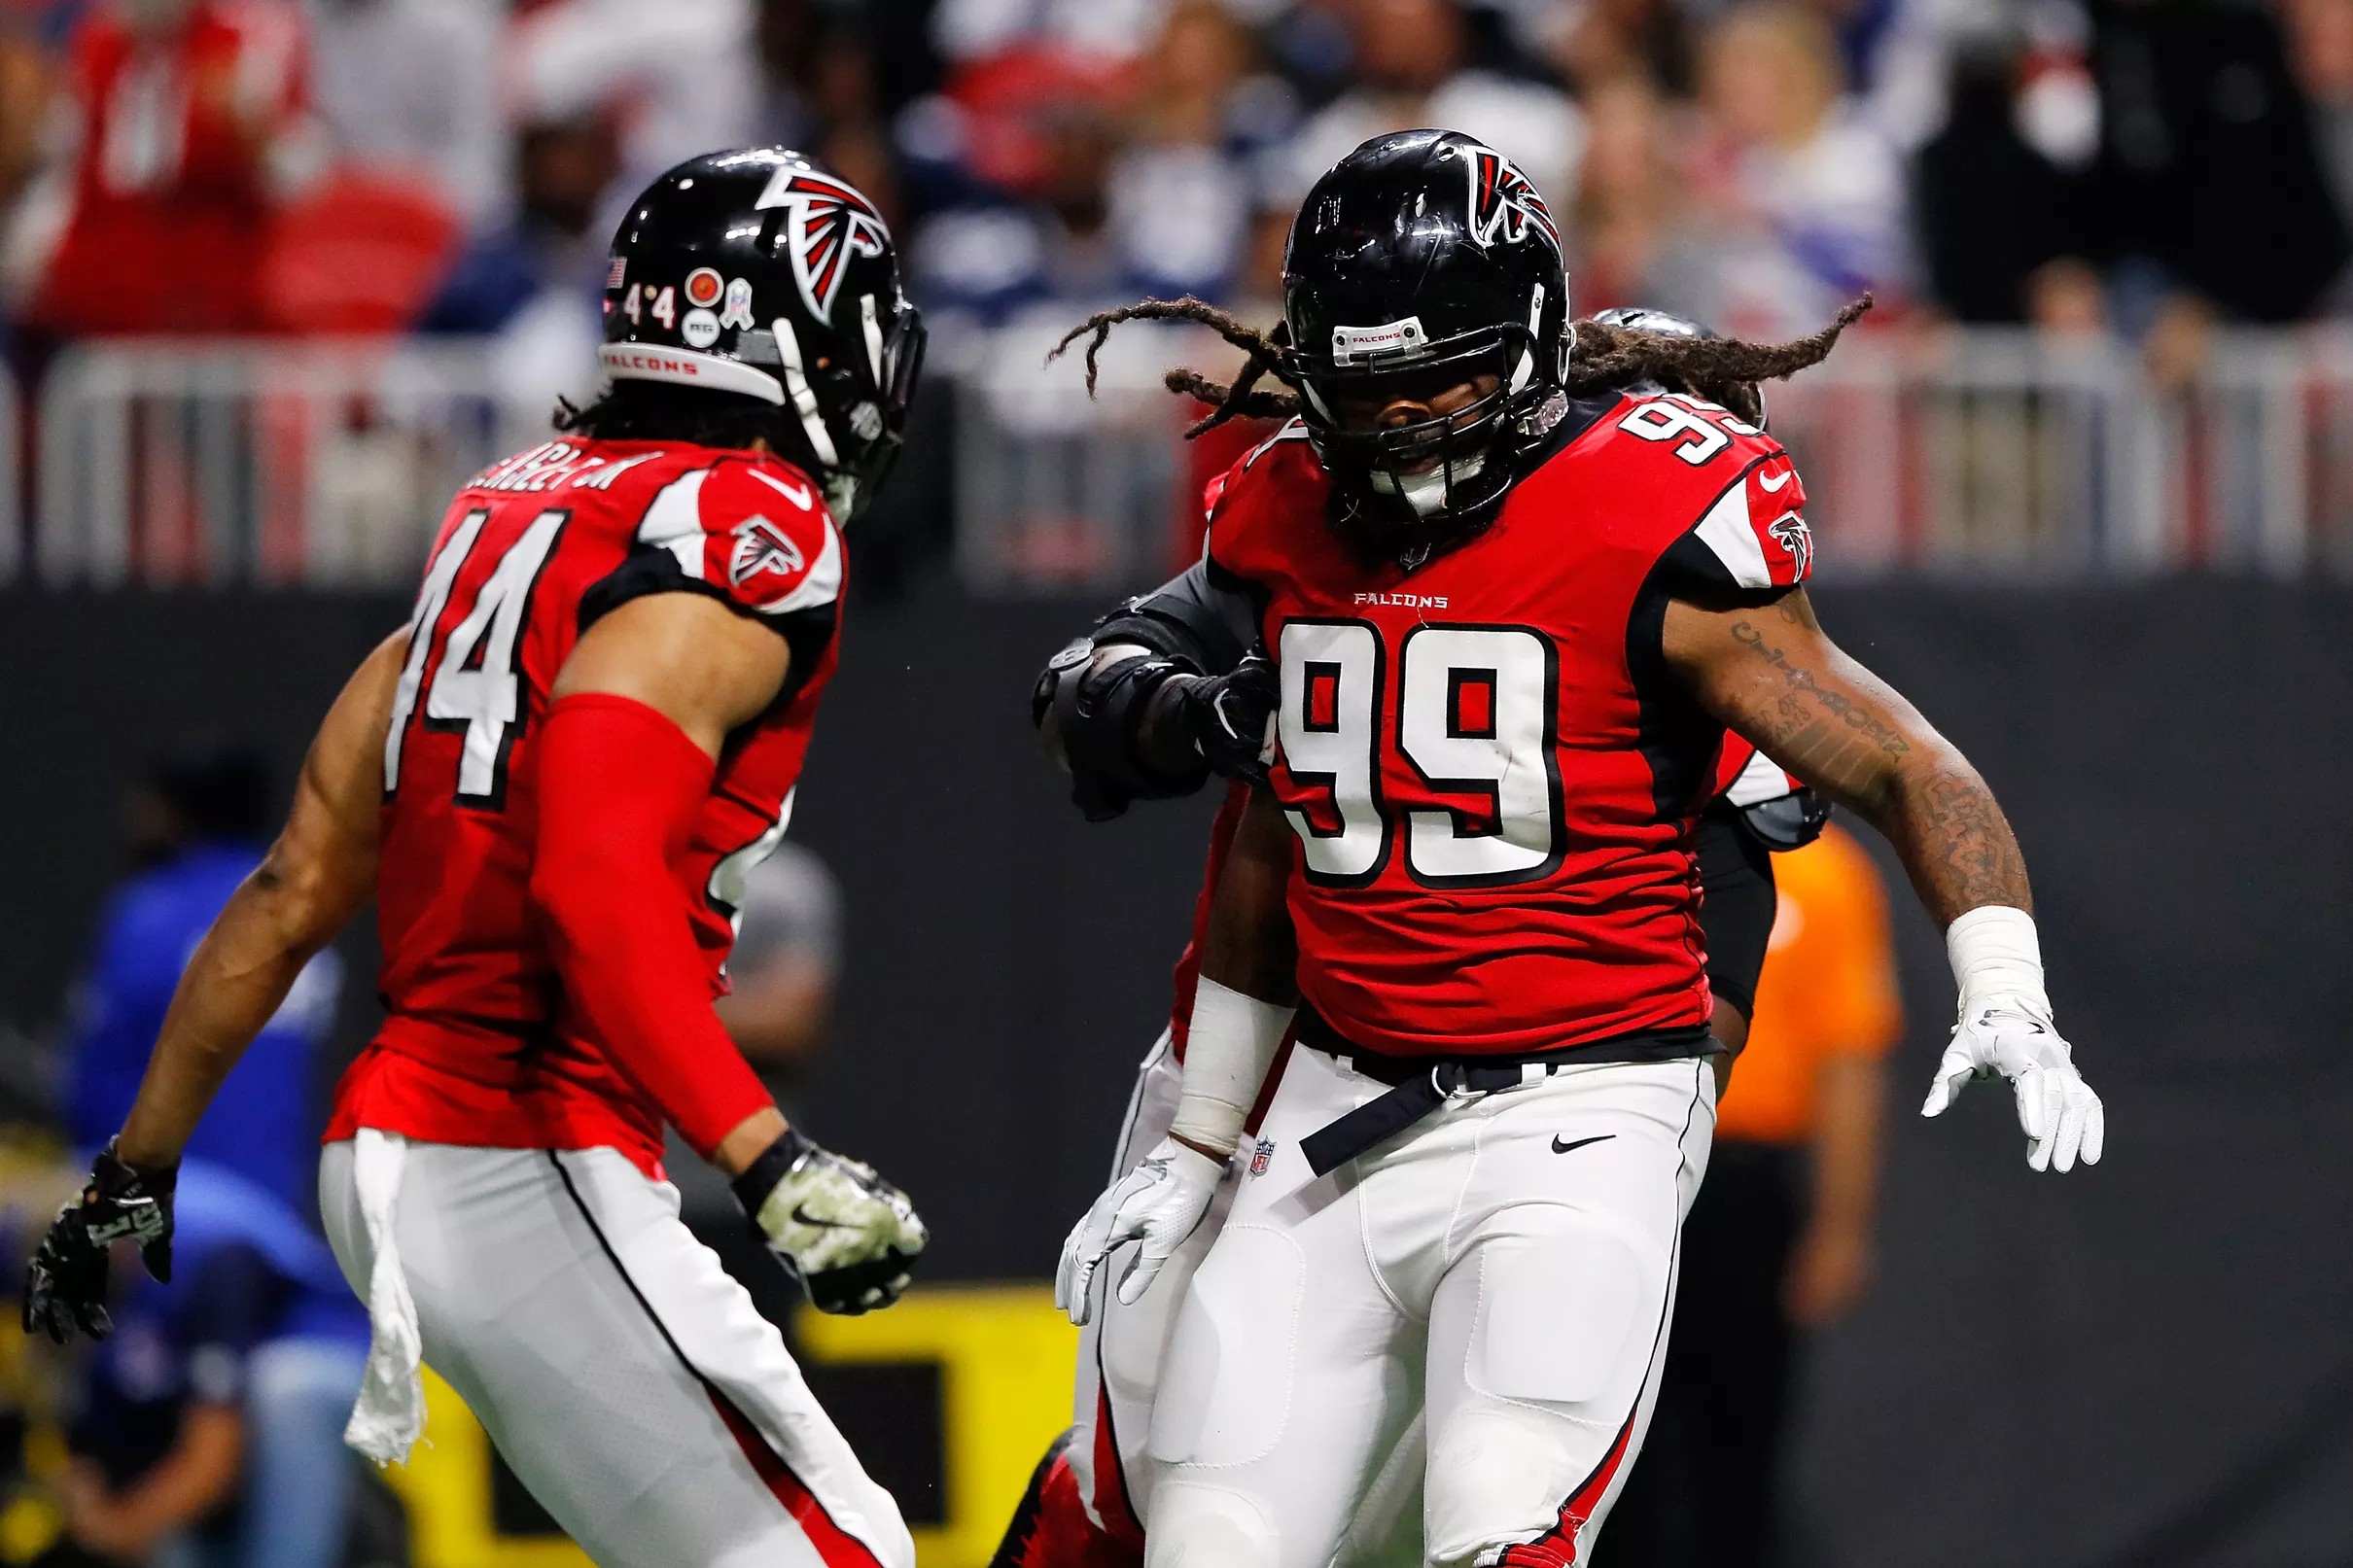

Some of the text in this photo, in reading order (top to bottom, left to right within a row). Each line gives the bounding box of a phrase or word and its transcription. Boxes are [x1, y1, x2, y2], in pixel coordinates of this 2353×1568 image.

[623, 282, 677, 330] 44
[1352, 331, 1401, 343] FALCONS
[1353, 592, 1449, 609] FALCONS
[383, 508, 572, 811] 44
[1278, 616, 1566, 889] 99
